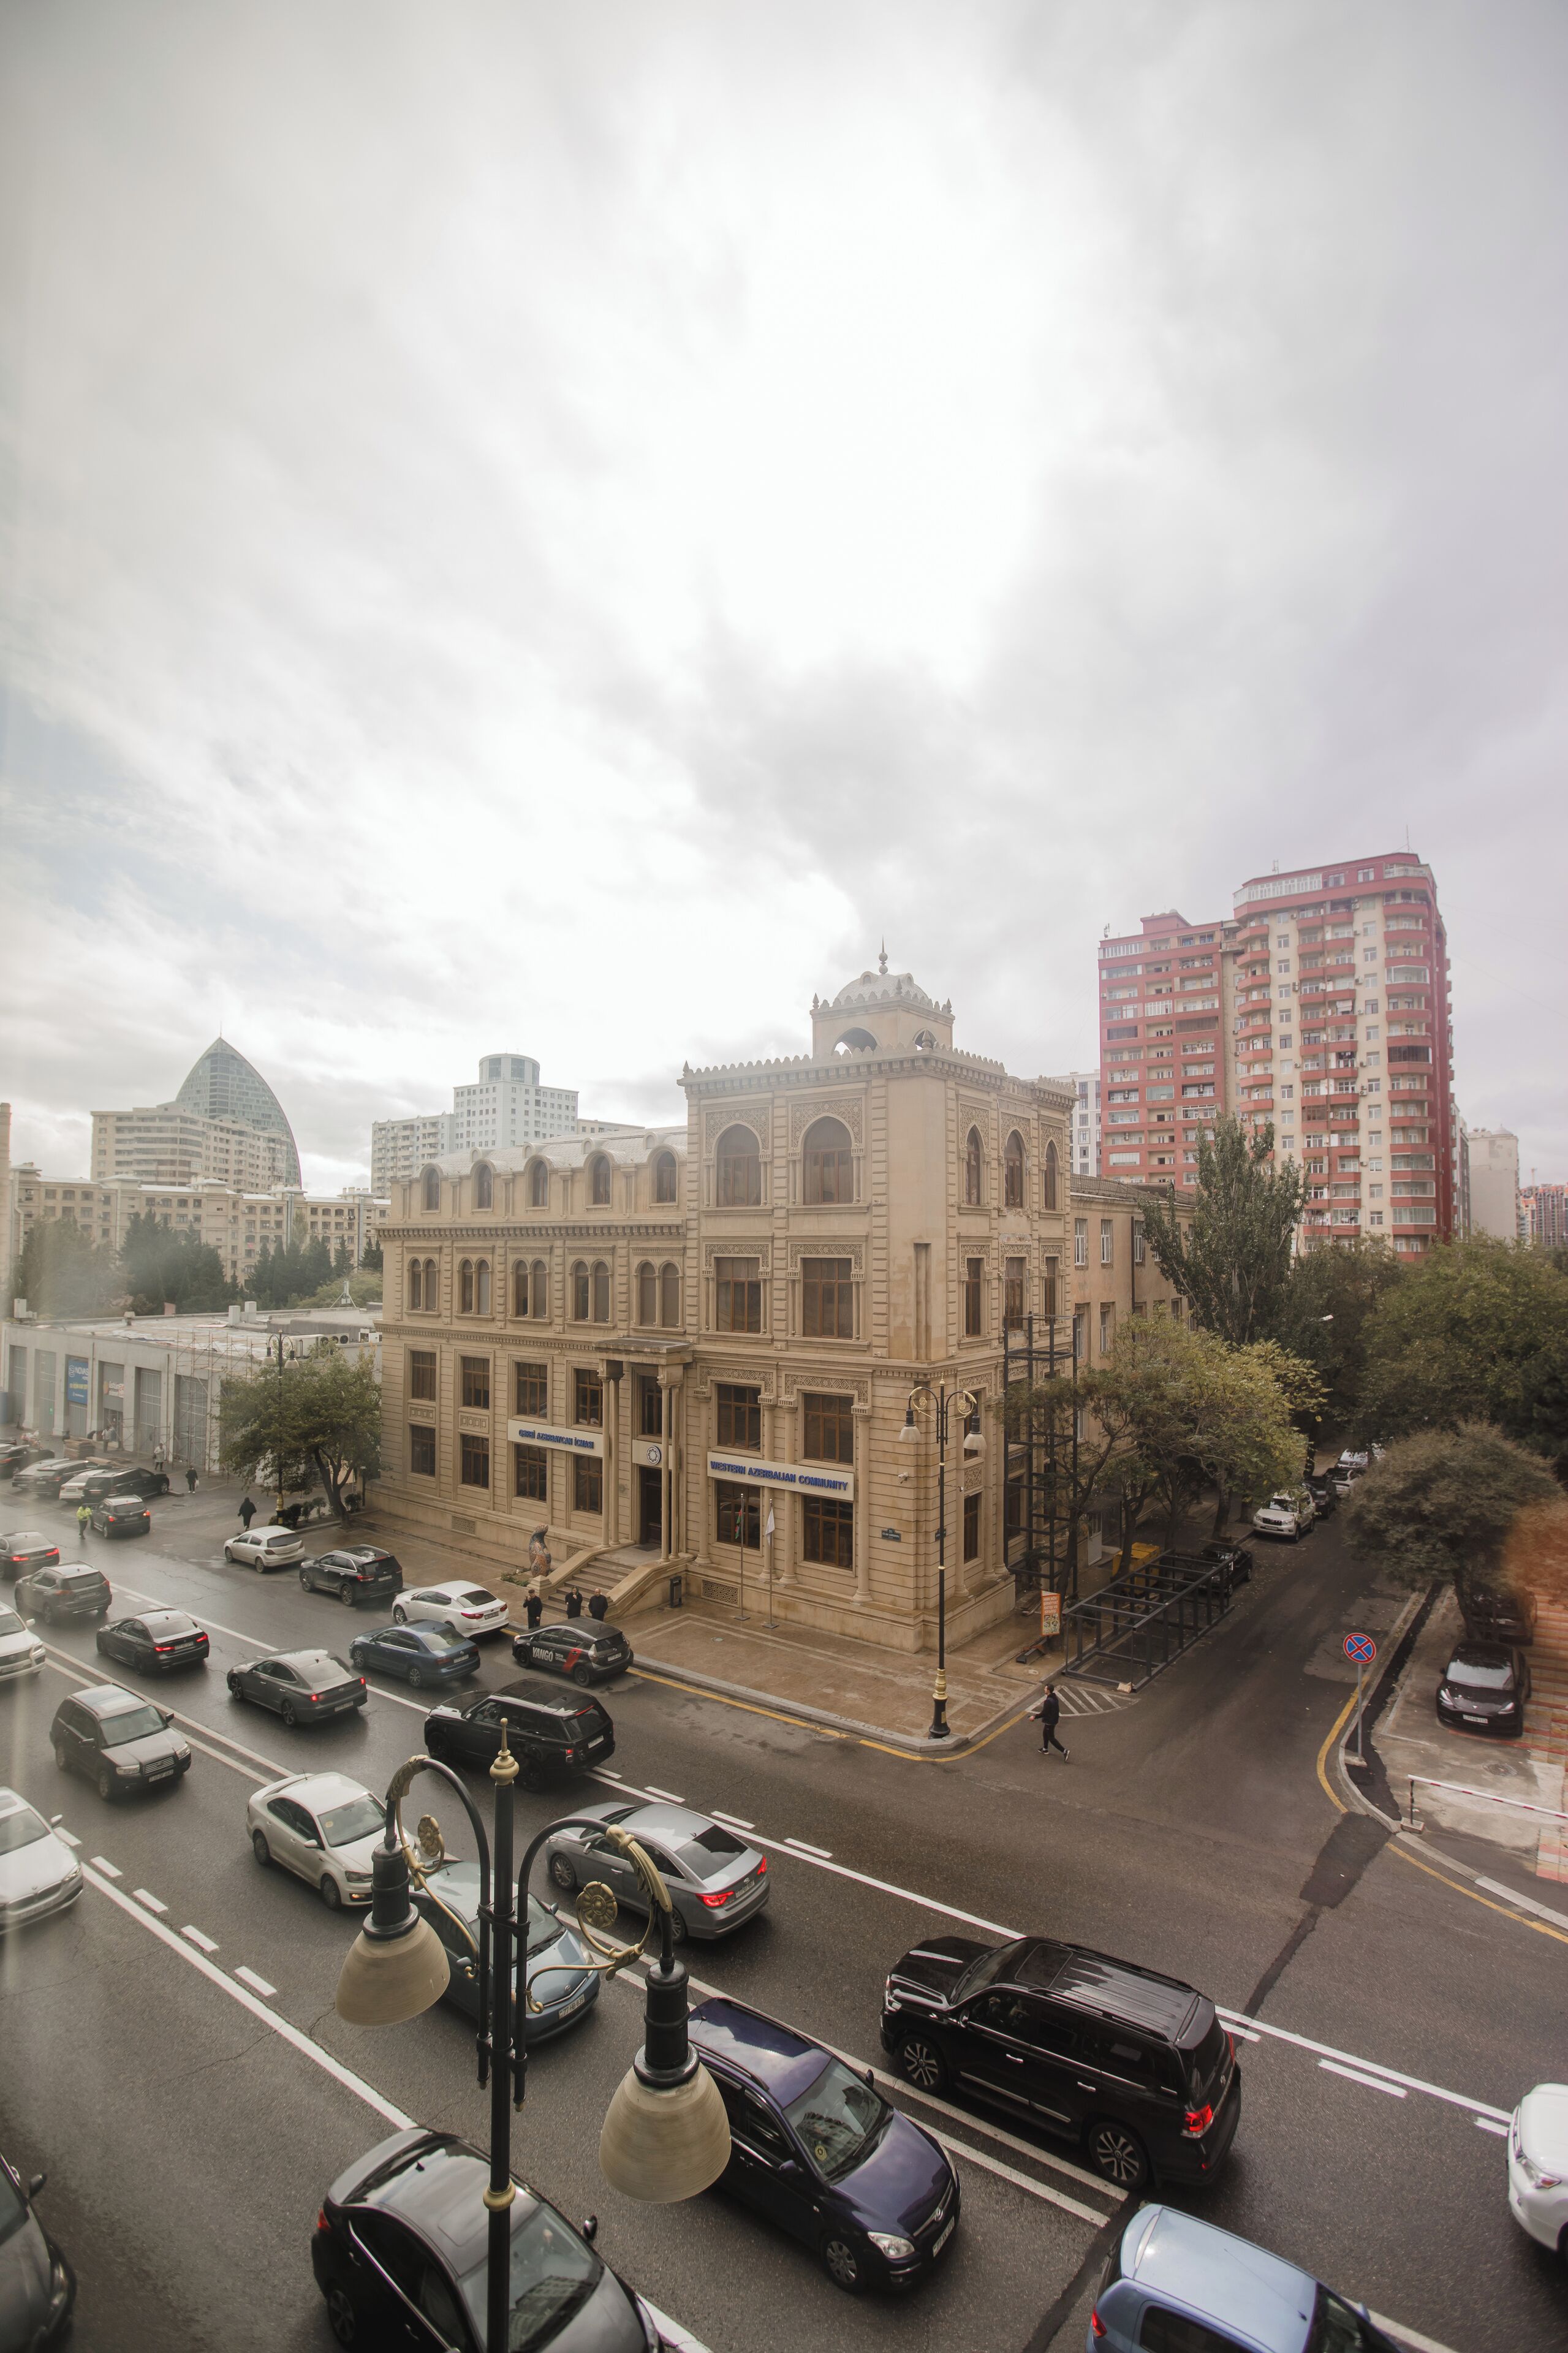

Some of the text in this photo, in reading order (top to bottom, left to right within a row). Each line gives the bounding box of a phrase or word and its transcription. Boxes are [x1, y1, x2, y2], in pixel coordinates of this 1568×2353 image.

[537, 1432, 573, 1446] AZƏRBAYCAN
[574, 1437, 594, 1449] İCMASI
[710, 1461, 849, 1491] WESTERN AZERBAIJAN COMMUNITY
